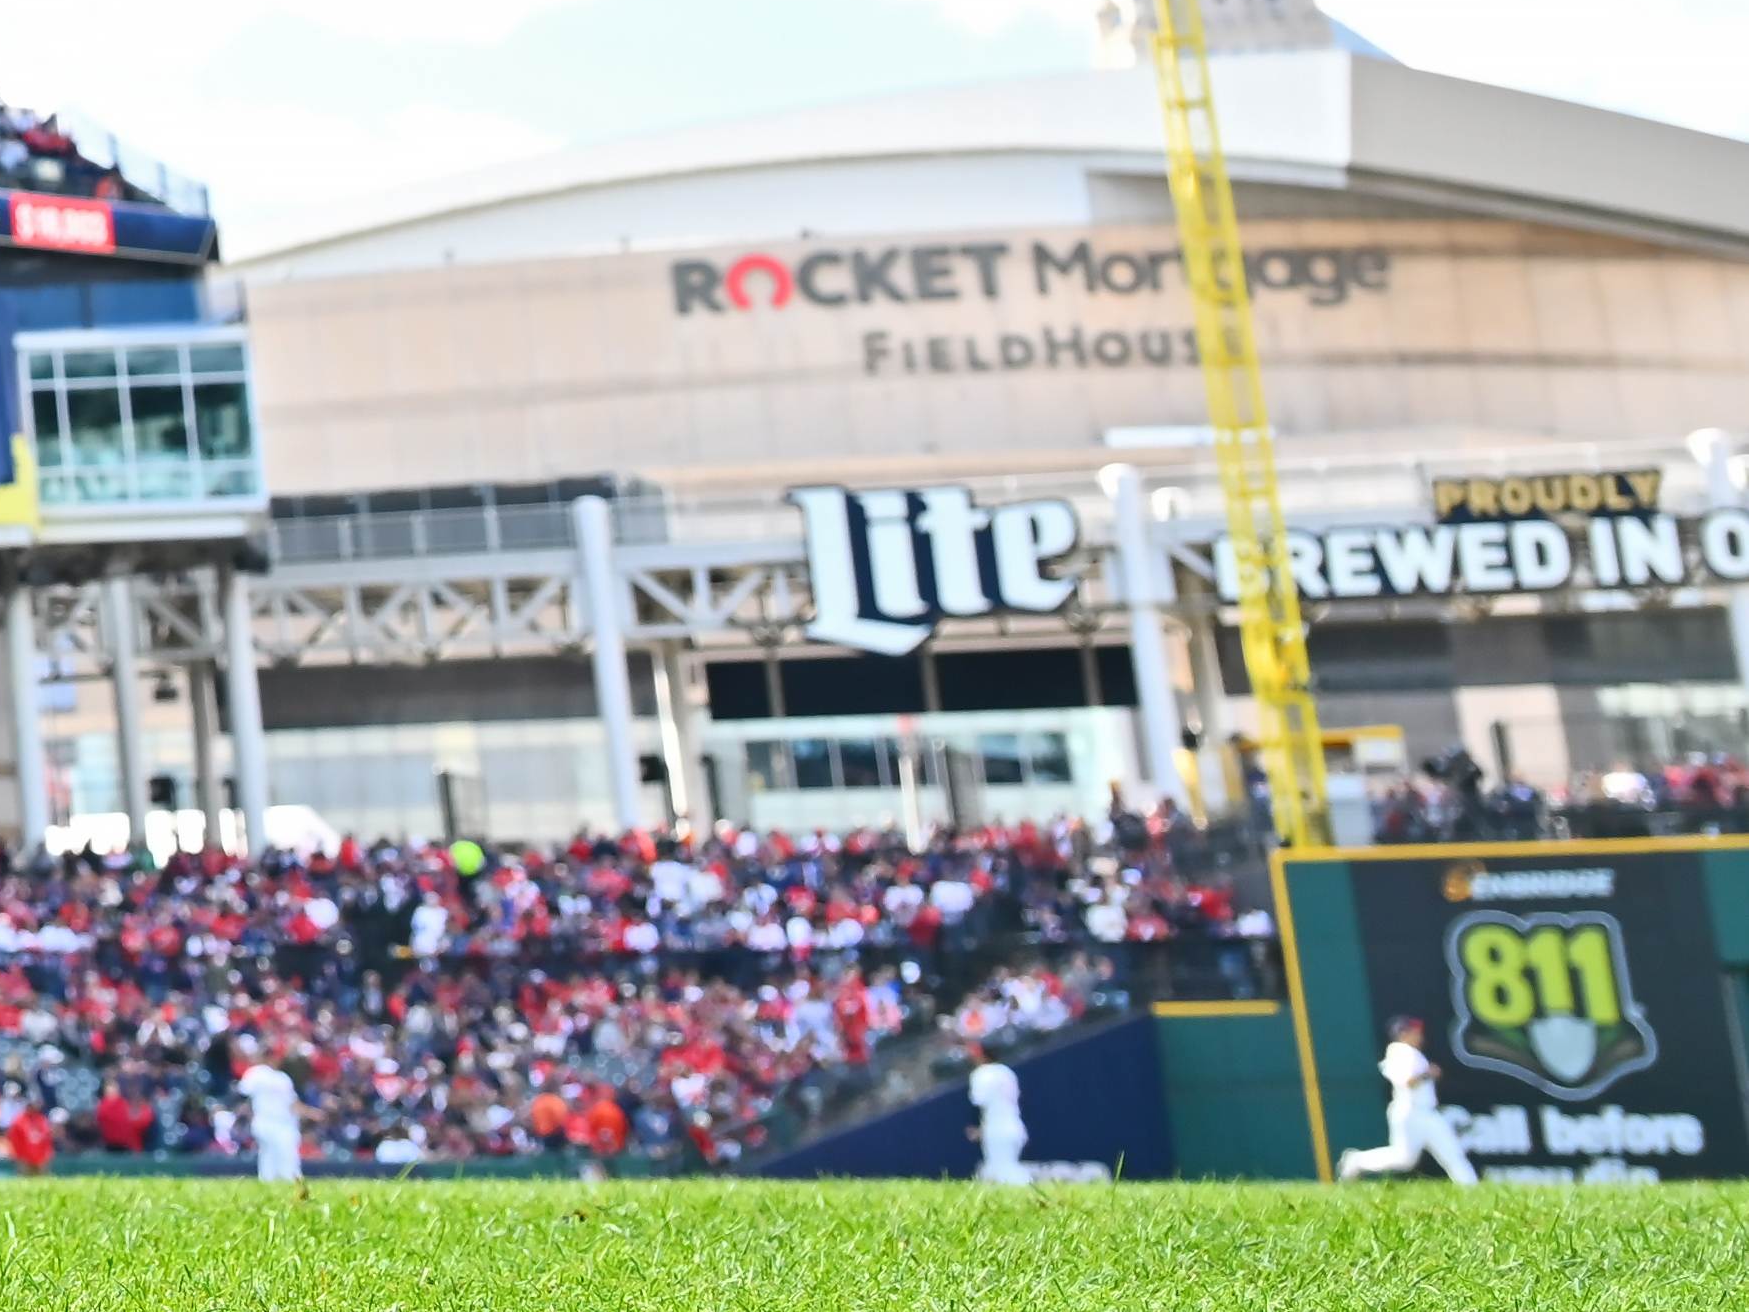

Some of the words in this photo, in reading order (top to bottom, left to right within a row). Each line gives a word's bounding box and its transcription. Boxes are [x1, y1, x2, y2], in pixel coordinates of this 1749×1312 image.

[673, 242, 1007, 314] ROCKET
[1434, 469, 1661, 516] PROUDLY
[784, 483, 1079, 656] Lite
[1589, 513, 1685, 587] IN
[1463, 925, 1621, 1027] 811
[1538, 1103, 1704, 1156] before
